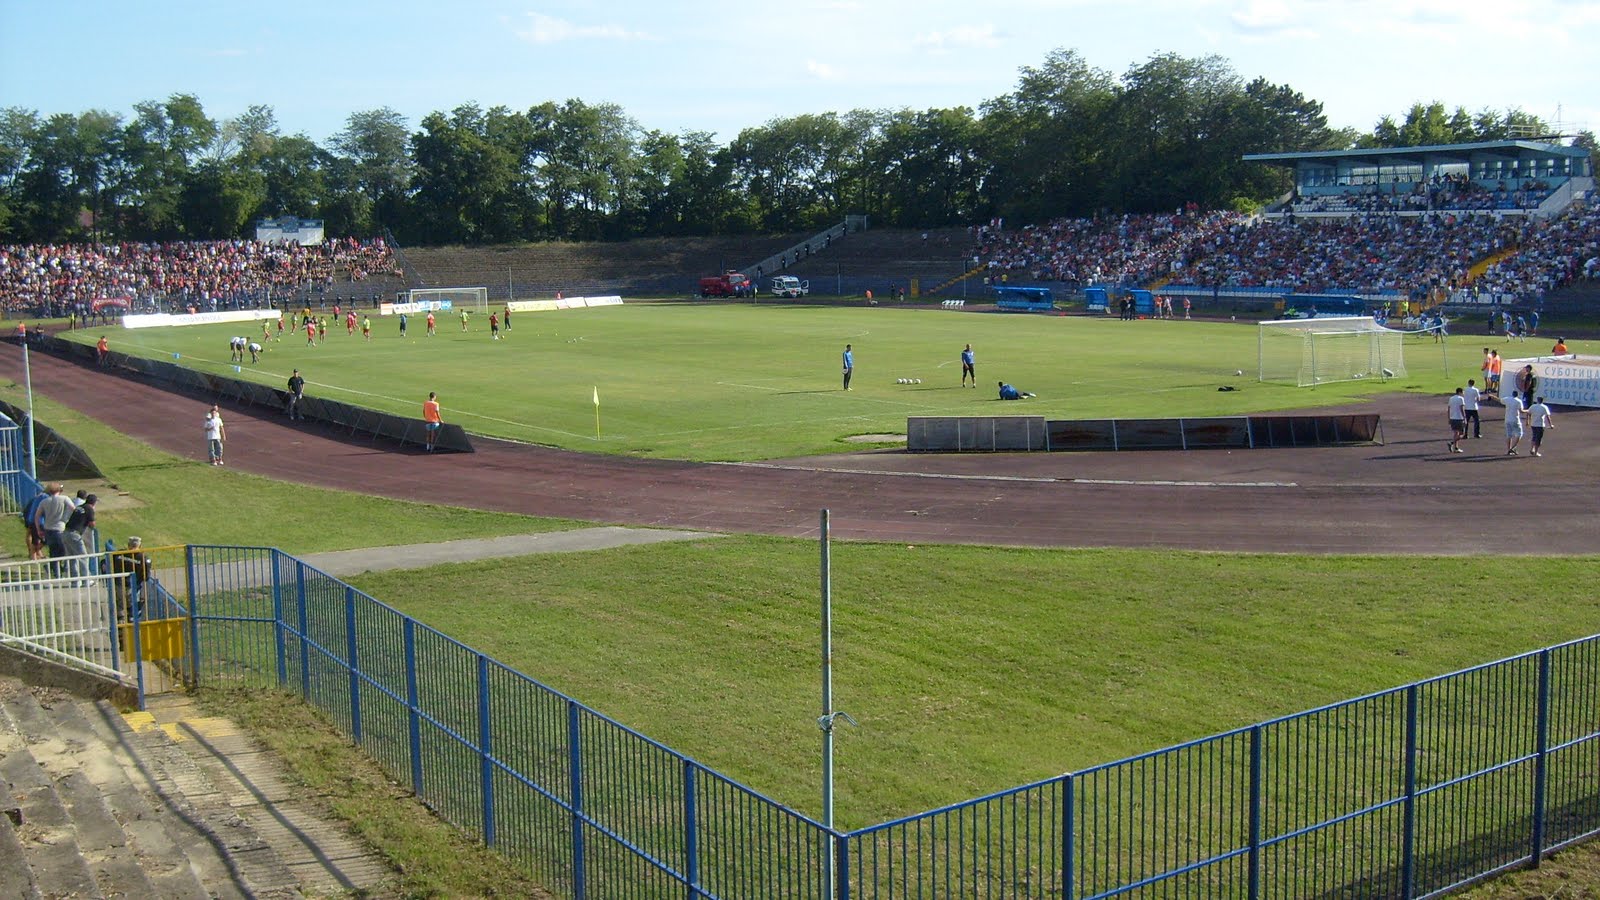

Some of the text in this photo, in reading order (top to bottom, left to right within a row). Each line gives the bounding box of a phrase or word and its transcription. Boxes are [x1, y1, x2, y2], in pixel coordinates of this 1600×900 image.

[1544, 366, 1600, 379] СУБОТИЦА
[1543, 378, 1599, 391] SZABADKA
[1543, 390, 1596, 402] SUBOTICA
